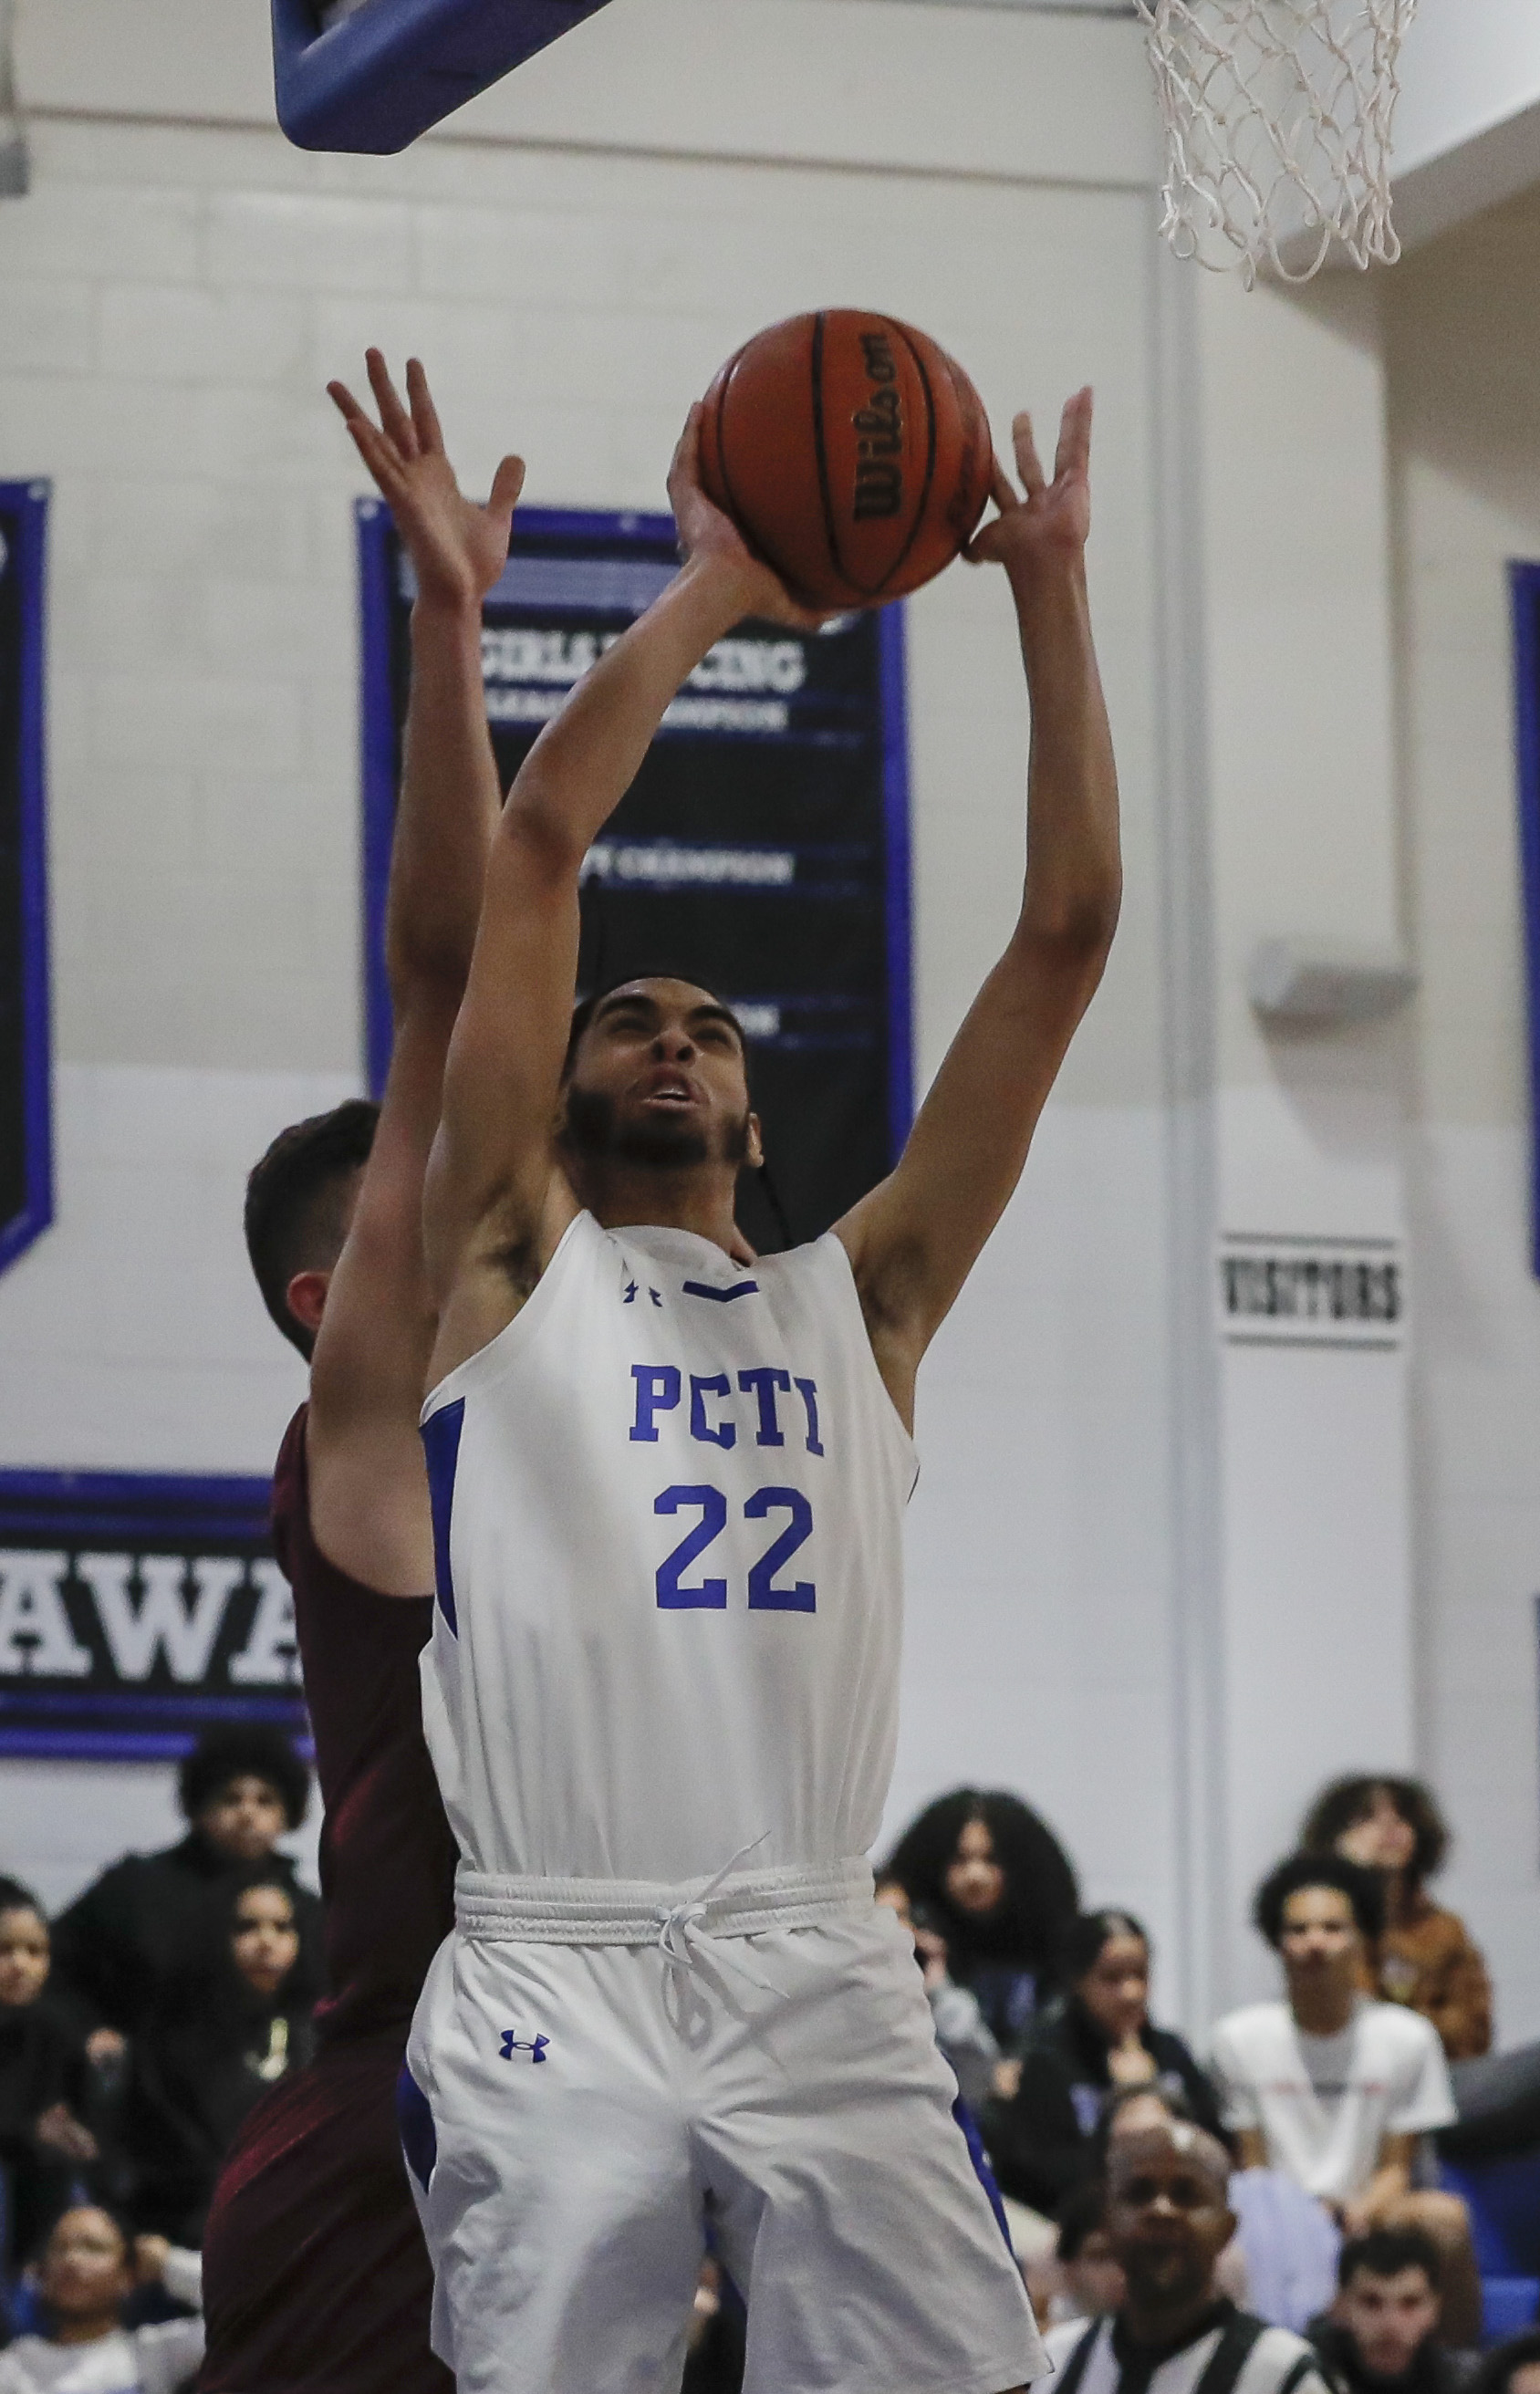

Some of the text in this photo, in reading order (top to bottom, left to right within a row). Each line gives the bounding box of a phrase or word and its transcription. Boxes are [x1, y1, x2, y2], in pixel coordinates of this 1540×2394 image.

[852, 333, 902, 524] Wilson
[1222, 1256, 1400, 1323] VISITORS
[630, 1364, 825, 1458] PCTI
[653, 1484, 817, 1614] 22
